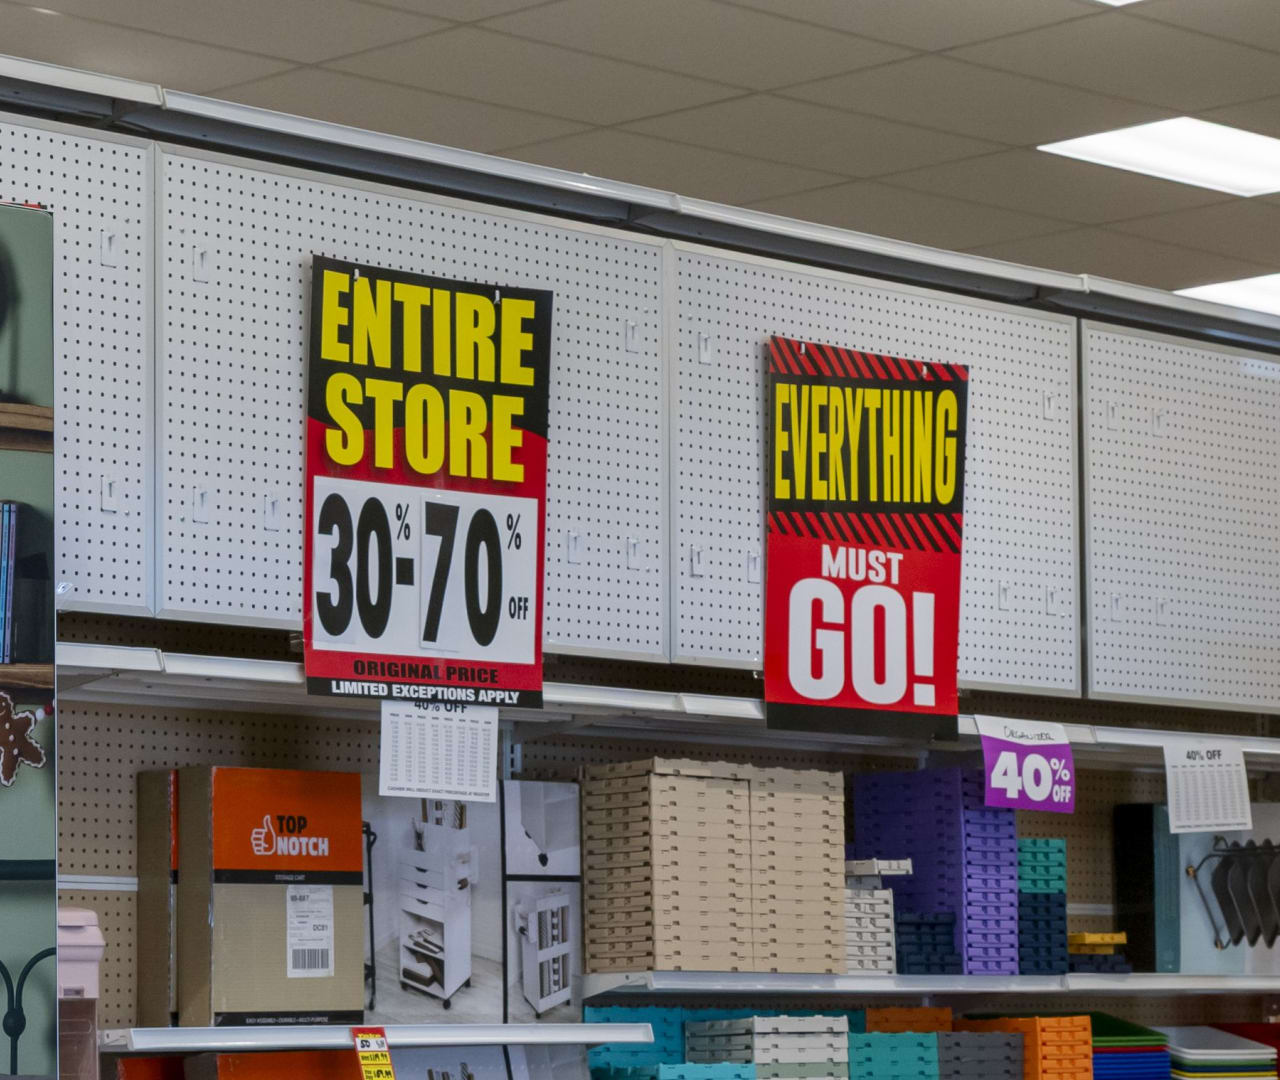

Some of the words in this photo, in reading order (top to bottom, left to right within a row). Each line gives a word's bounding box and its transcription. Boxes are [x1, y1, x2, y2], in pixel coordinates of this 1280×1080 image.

[320, 269, 535, 386] ENTIRE
[324, 372, 525, 484] STORE
[774, 383, 958, 504] EVERYTHING
[821, 544, 904, 585] MUST
[508, 595, 529, 621] OFF
[788, 578, 936, 708] GO!
[353, 660, 441, 680] ORIGINAL
[446, 667, 499, 684] PRICE
[332, 680, 388, 696] LIMITED
[392, 684, 475, 701] EXCEPTIONS
[478, 688, 520, 704] APPLY
[1207, 750, 1222, 760] OFF
[991, 750, 1071, 802] 40%
[1052, 784, 1071, 803] OFF
[277, 815, 307, 834] TOP
[277, 837, 329, 856] NOTCH
